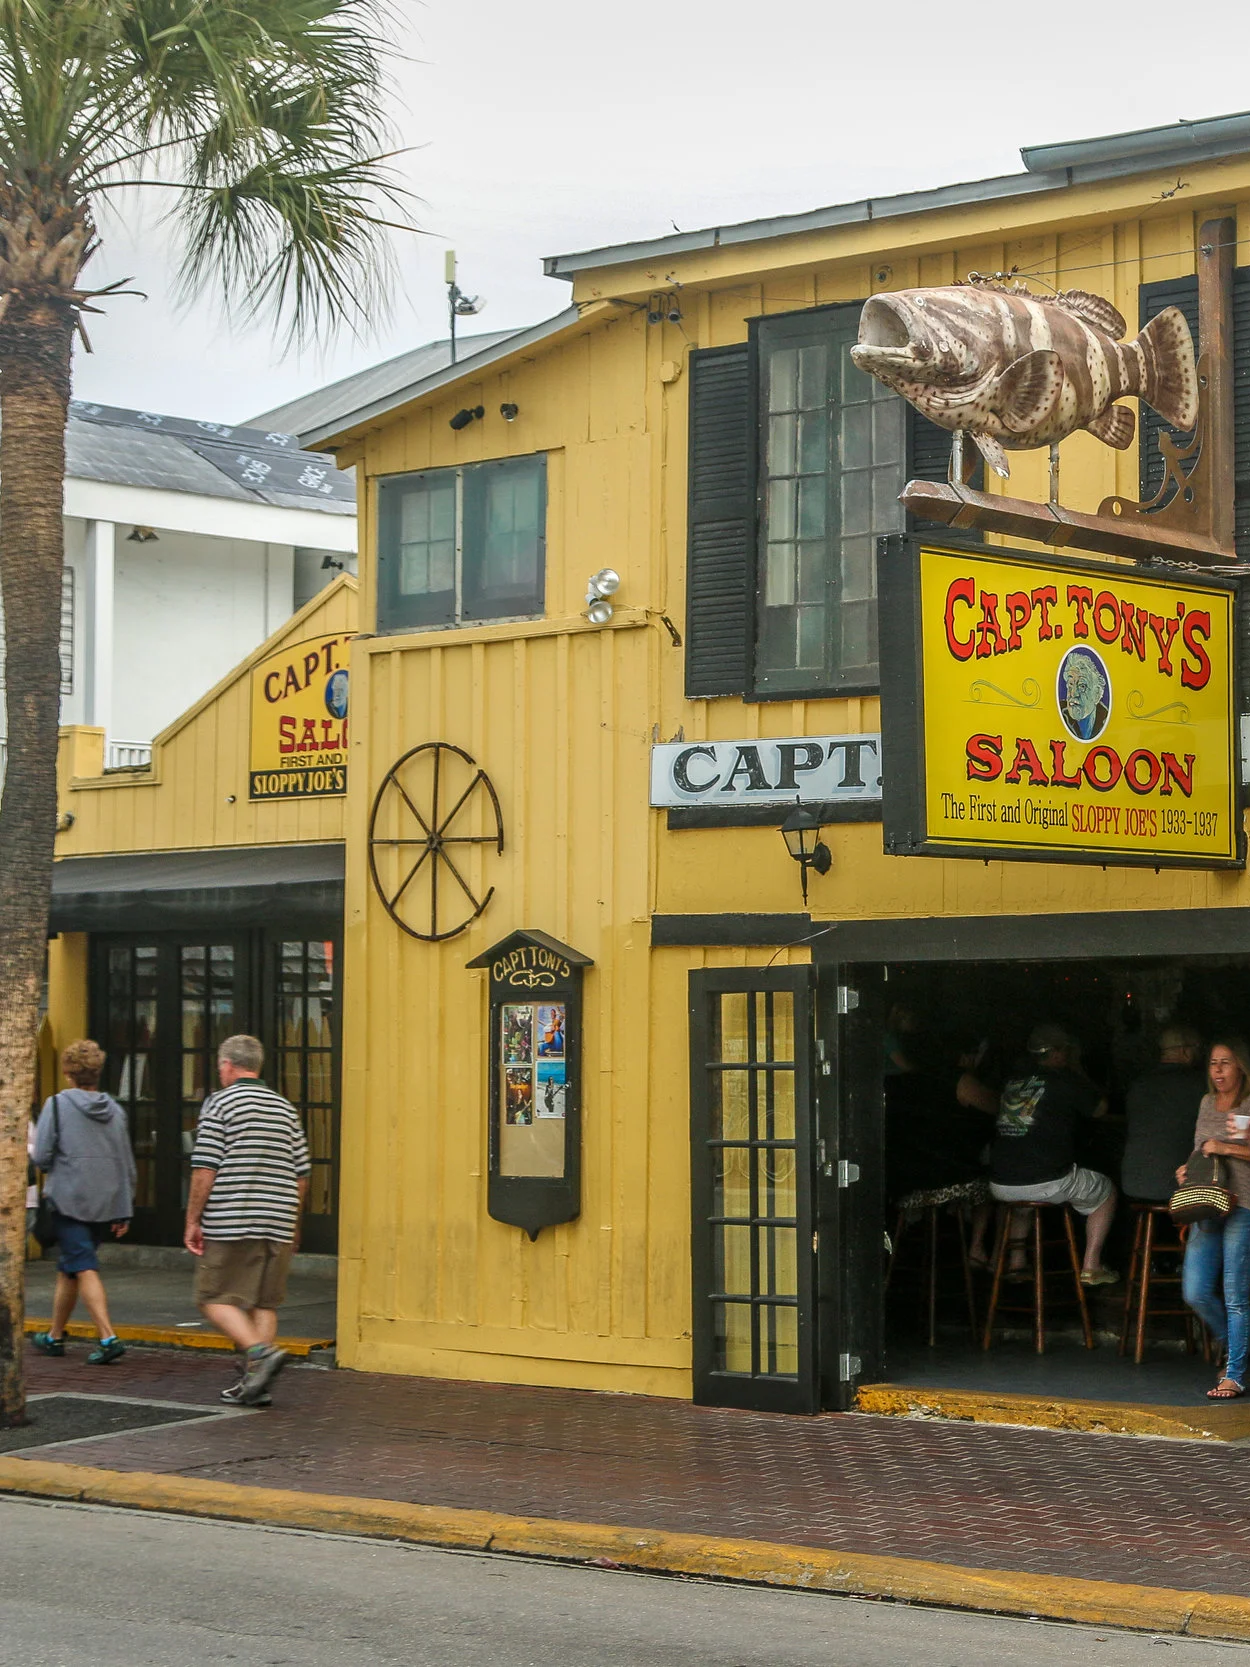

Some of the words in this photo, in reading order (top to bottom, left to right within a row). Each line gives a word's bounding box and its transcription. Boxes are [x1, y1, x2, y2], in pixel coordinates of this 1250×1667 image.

[944, 577, 1062, 662] CAPT.
[1066, 584, 1211, 691] TONY'S
[264, 639, 339, 704] CAPT.
[253, 773, 306, 795] SLOPPY
[306, 767, 344, 793] JOE'S
[280, 755, 314, 769] FIRST
[316, 754, 343, 766] AND
[966, 734, 1196, 798] SALOON
[941, 793, 965, 820] The
[969, 795, 997, 823] First
[1000, 799, 1021, 824] and
[1024, 799, 1068, 830] Original
[1071, 806, 1121, 836] SLOPPY
[1124, 808, 1157, 837] JOE'S
[1161, 809, 1218, 837] 1933-1937
[493, 947, 527, 982] CAPT
